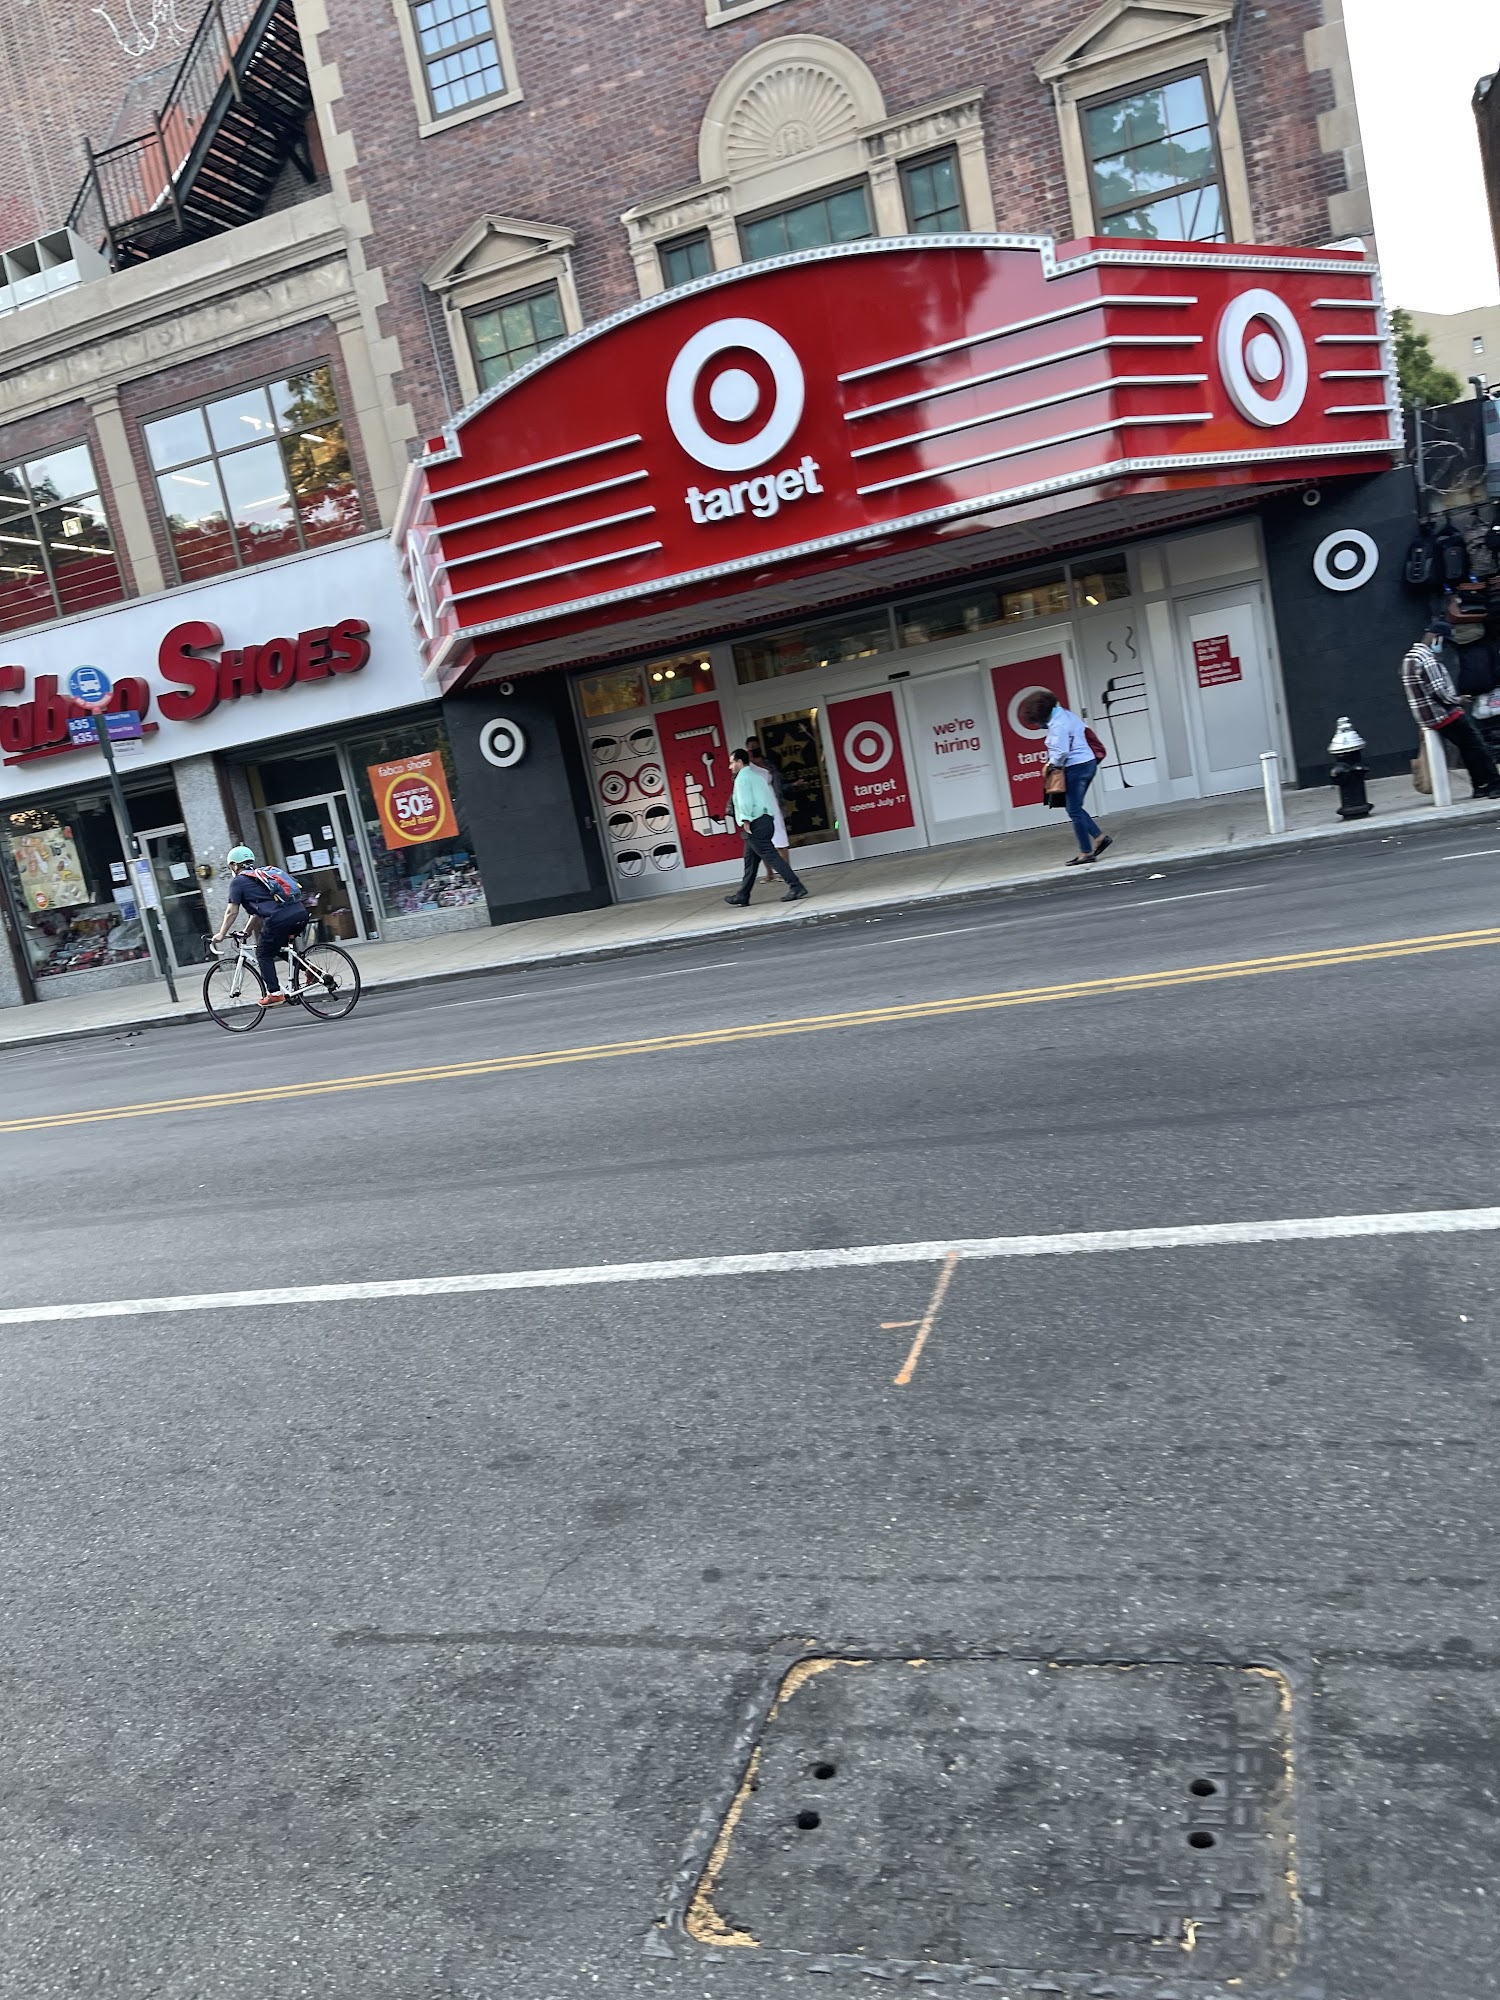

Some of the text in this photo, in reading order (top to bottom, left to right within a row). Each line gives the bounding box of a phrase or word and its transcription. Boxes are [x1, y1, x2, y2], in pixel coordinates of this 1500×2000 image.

[684, 455, 825, 524] target
[0, 618, 371, 752] abo SHOES
[68, 719, 90, 731] B35
[933, 718, 975, 735] we're
[73, 731, 94, 744] B35
[934, 737, 981, 755] hiring
[1017, 750, 1048, 764] targ
[1012, 771, 1041, 781] opens
[854, 778, 897, 796] target
[850, 794, 906, 812] opens July 17
[399, 815, 437, 829] 2nd item
